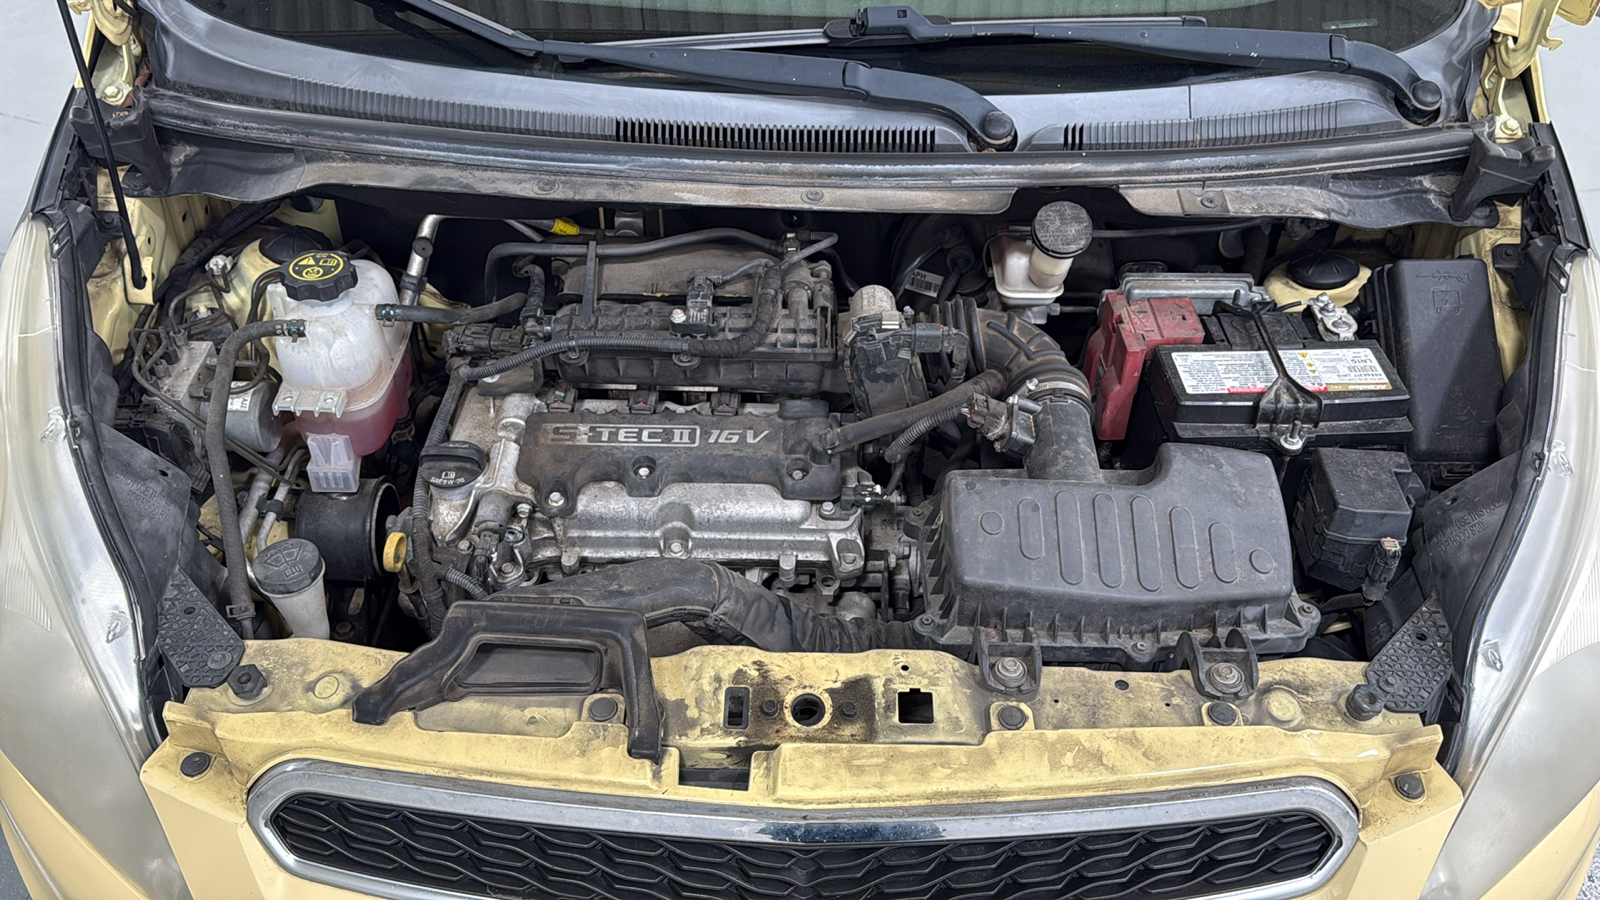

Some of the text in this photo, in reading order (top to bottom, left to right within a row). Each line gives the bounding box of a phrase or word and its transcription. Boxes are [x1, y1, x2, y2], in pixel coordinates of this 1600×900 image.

[708, 429, 770, 444] 16V
[134, 480, 151, 496] USE
[1454, 514, 1471, 529] USE
[1467, 506, 1485, 522] THIS
[1449, 529, 1471, 547] HOOD
